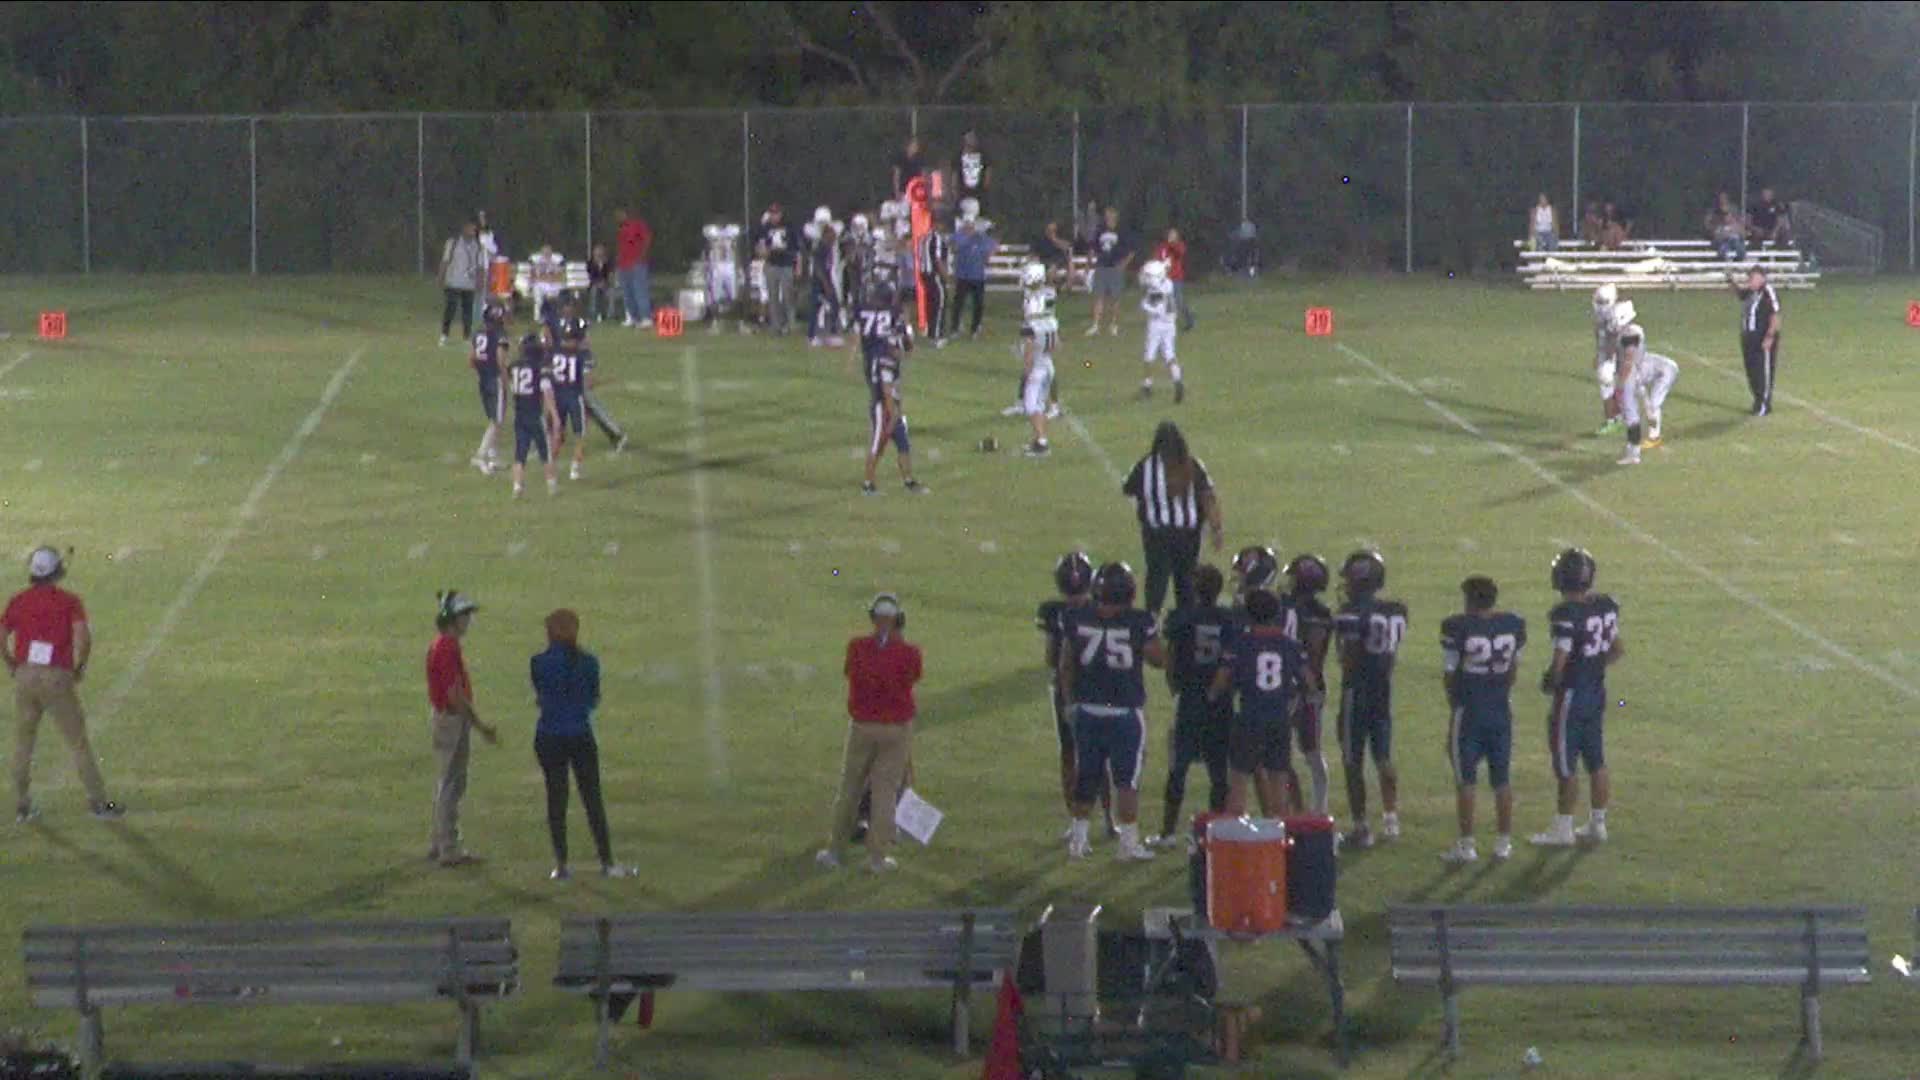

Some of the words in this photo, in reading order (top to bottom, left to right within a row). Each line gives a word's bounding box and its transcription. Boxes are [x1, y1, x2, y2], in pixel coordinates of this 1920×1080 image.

[860, 310, 892, 337] 72
[511, 366, 534, 395] 12
[552, 353, 577, 383] 21
[1077, 625, 1134, 670] 75
[1464, 634, 1517, 674] 23
[1256, 652, 1283, 691] 8
